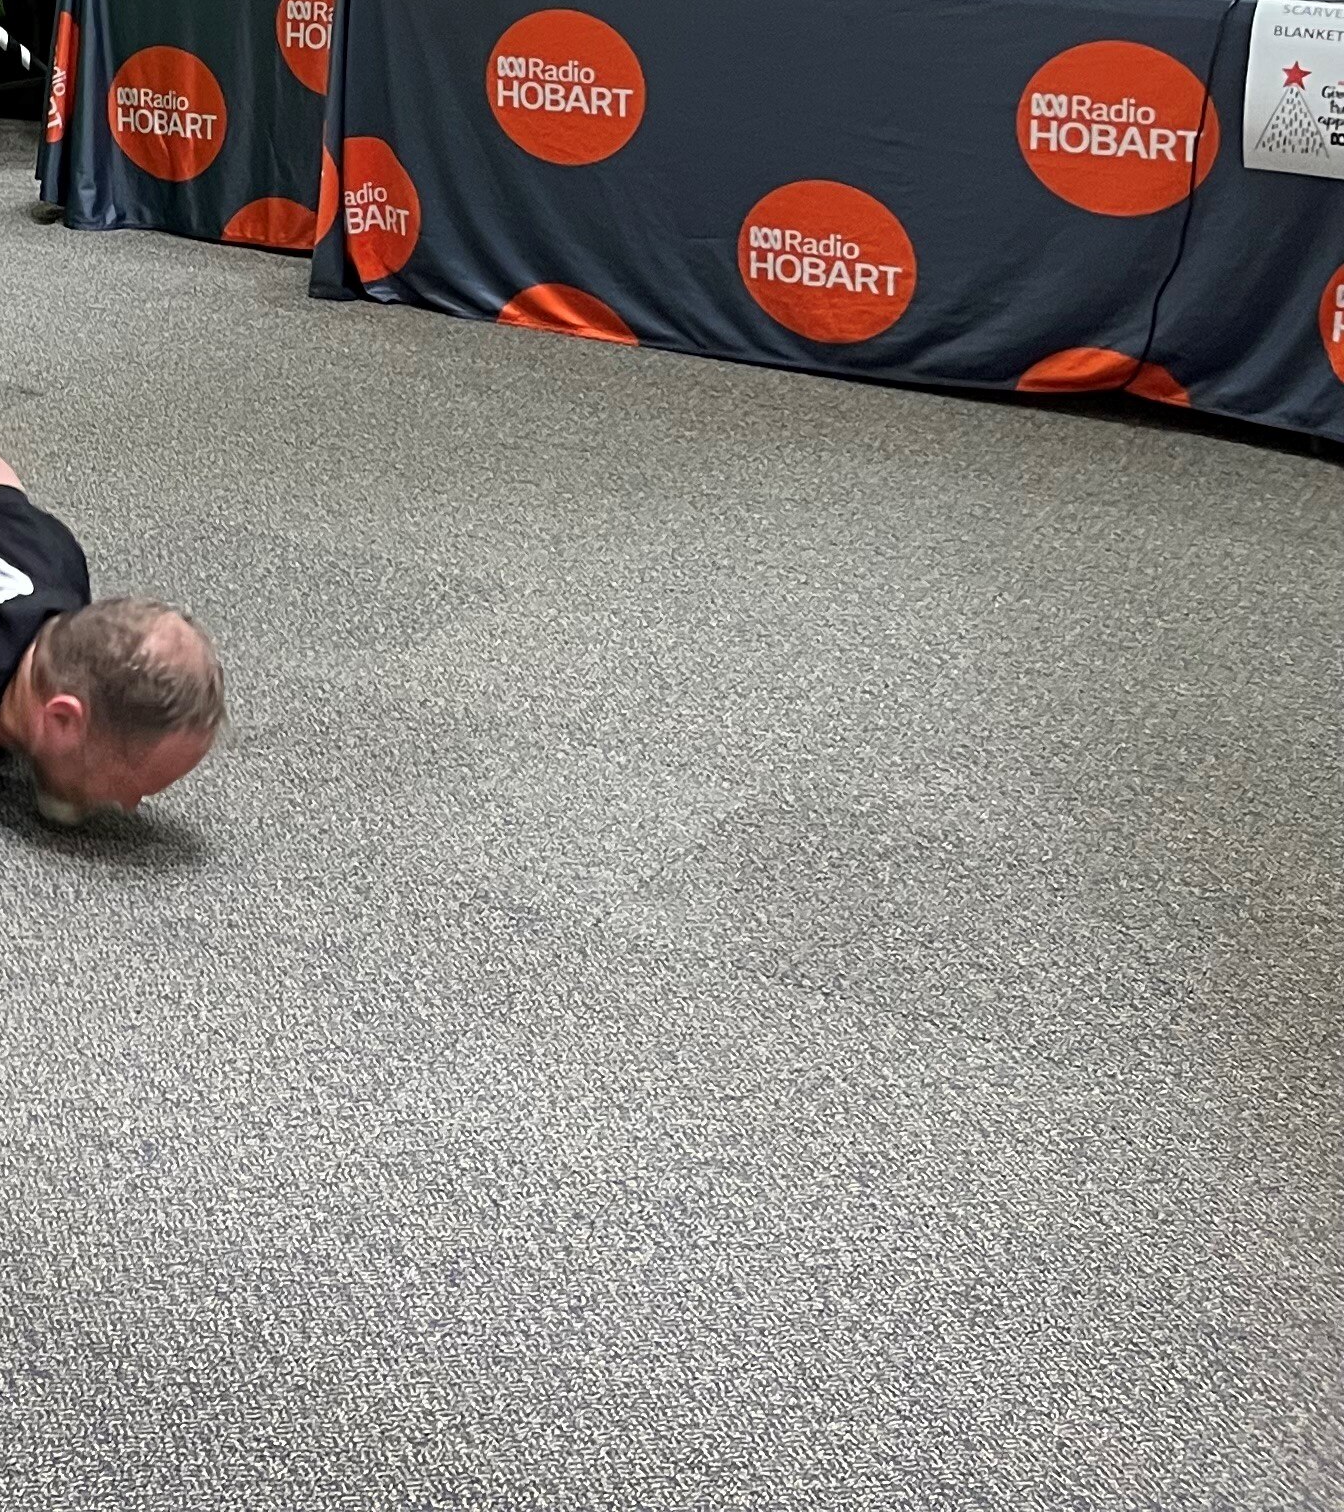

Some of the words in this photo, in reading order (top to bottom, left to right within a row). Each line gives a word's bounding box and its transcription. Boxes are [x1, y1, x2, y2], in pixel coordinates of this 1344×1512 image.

[528, 56, 595, 85] Radio
[140, 88, 189, 110] Radio
[497, 79, 633, 118] HOBART
[1071, 94, 1156, 125] Radio
[117, 107, 218, 140] HOBART
[1029, 119, 1204, 163] HOBART
[344, 182, 388, 206] adio
[344, 207, 410, 236] BART
[785, 229, 860, 261] Radio
[749, 251, 902, 297] HOBART
